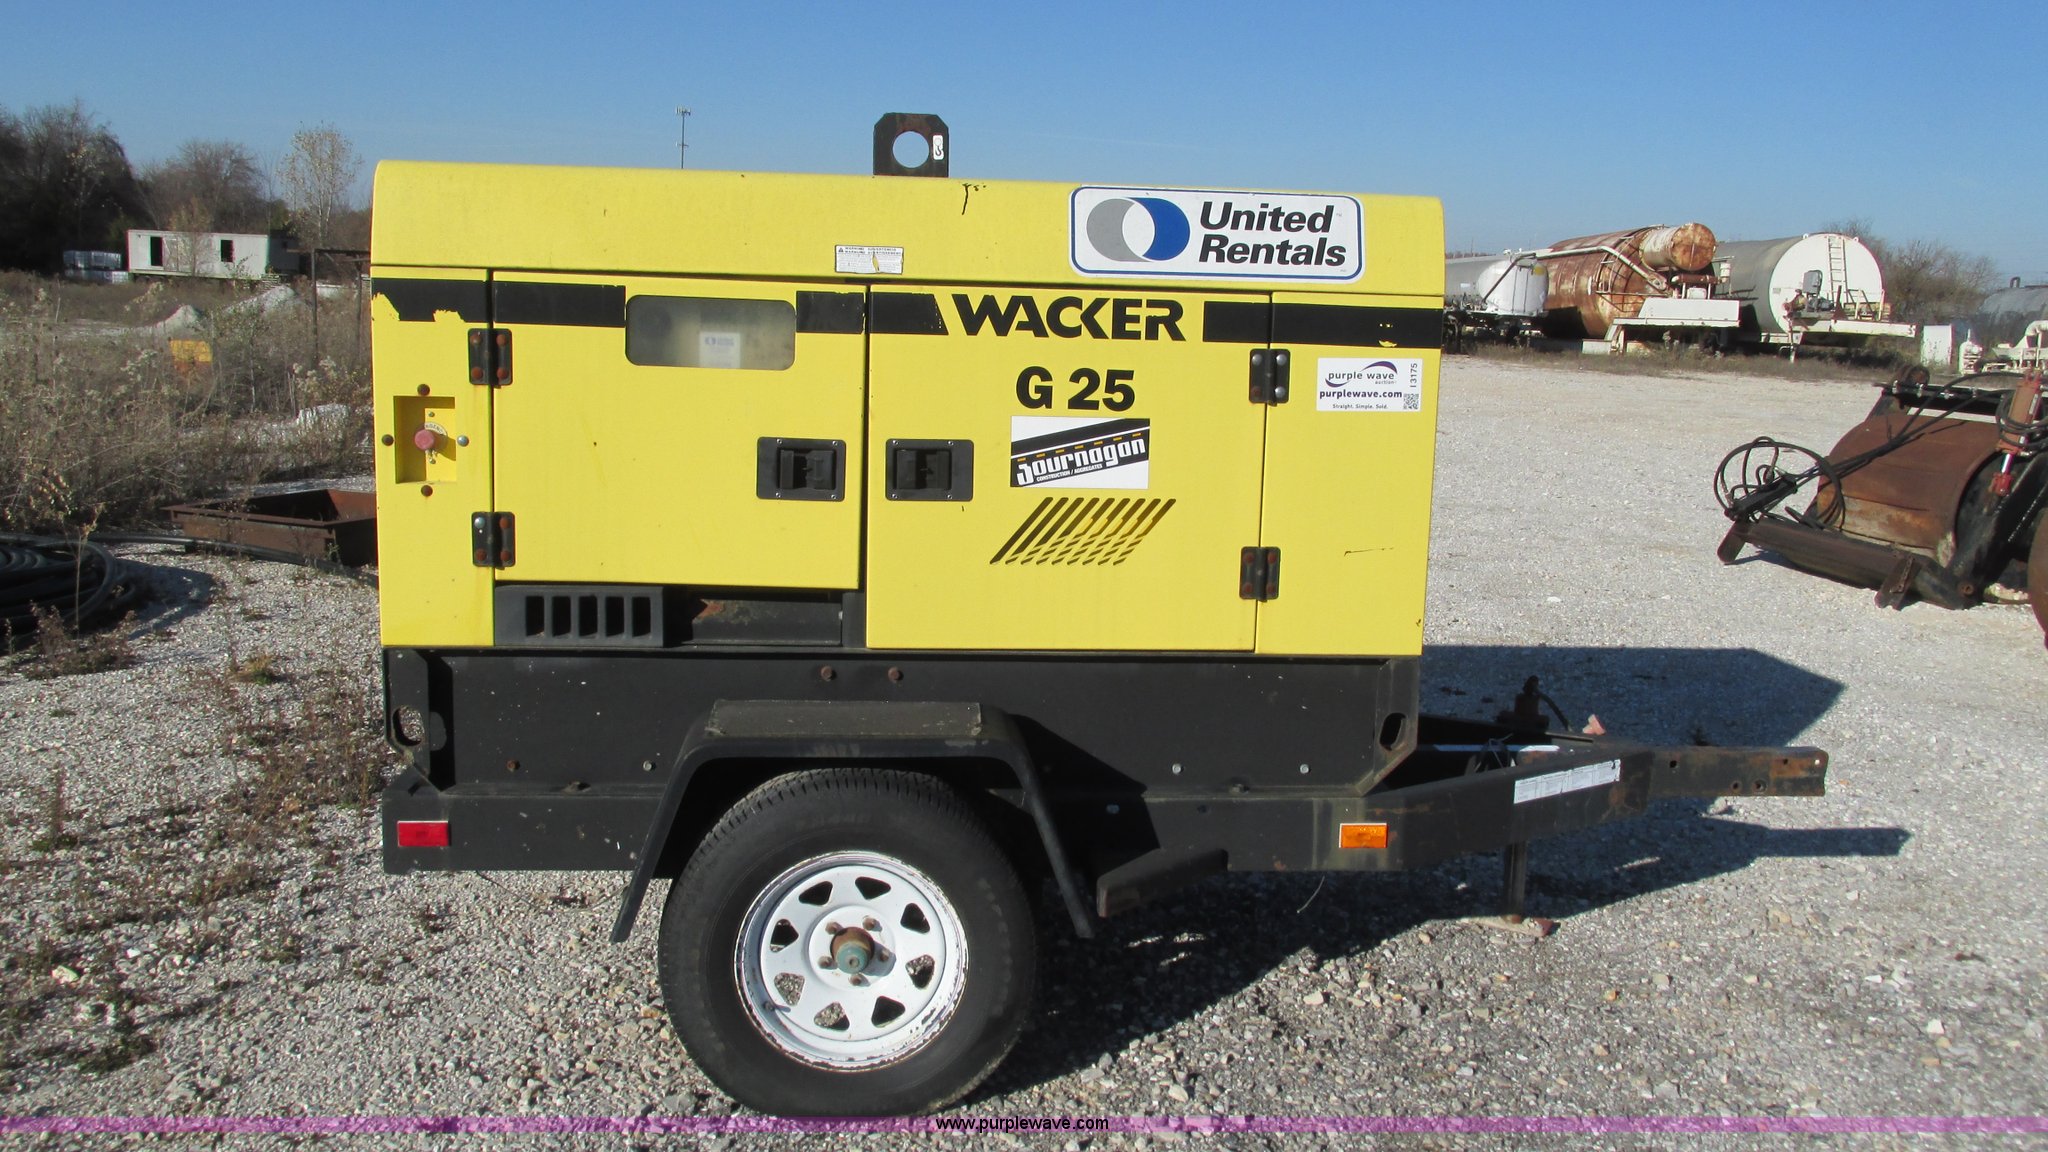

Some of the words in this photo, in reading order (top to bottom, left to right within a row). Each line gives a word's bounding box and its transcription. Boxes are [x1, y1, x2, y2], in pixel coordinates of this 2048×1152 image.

[1200, 201, 1335, 233] United
[1199, 234, 1346, 266] Rentals
[951, 293, 1186, 341] WACKER
[1016, 366, 1053, 409] G
[1067, 367, 1135, 412] 25
[1328, 372, 1363, 381] purple
[1409, 363, 1418, 388] 13175
[1320, 389, 1402, 399] purplewave.com
[1017, 439, 1146, 486] Journagan
